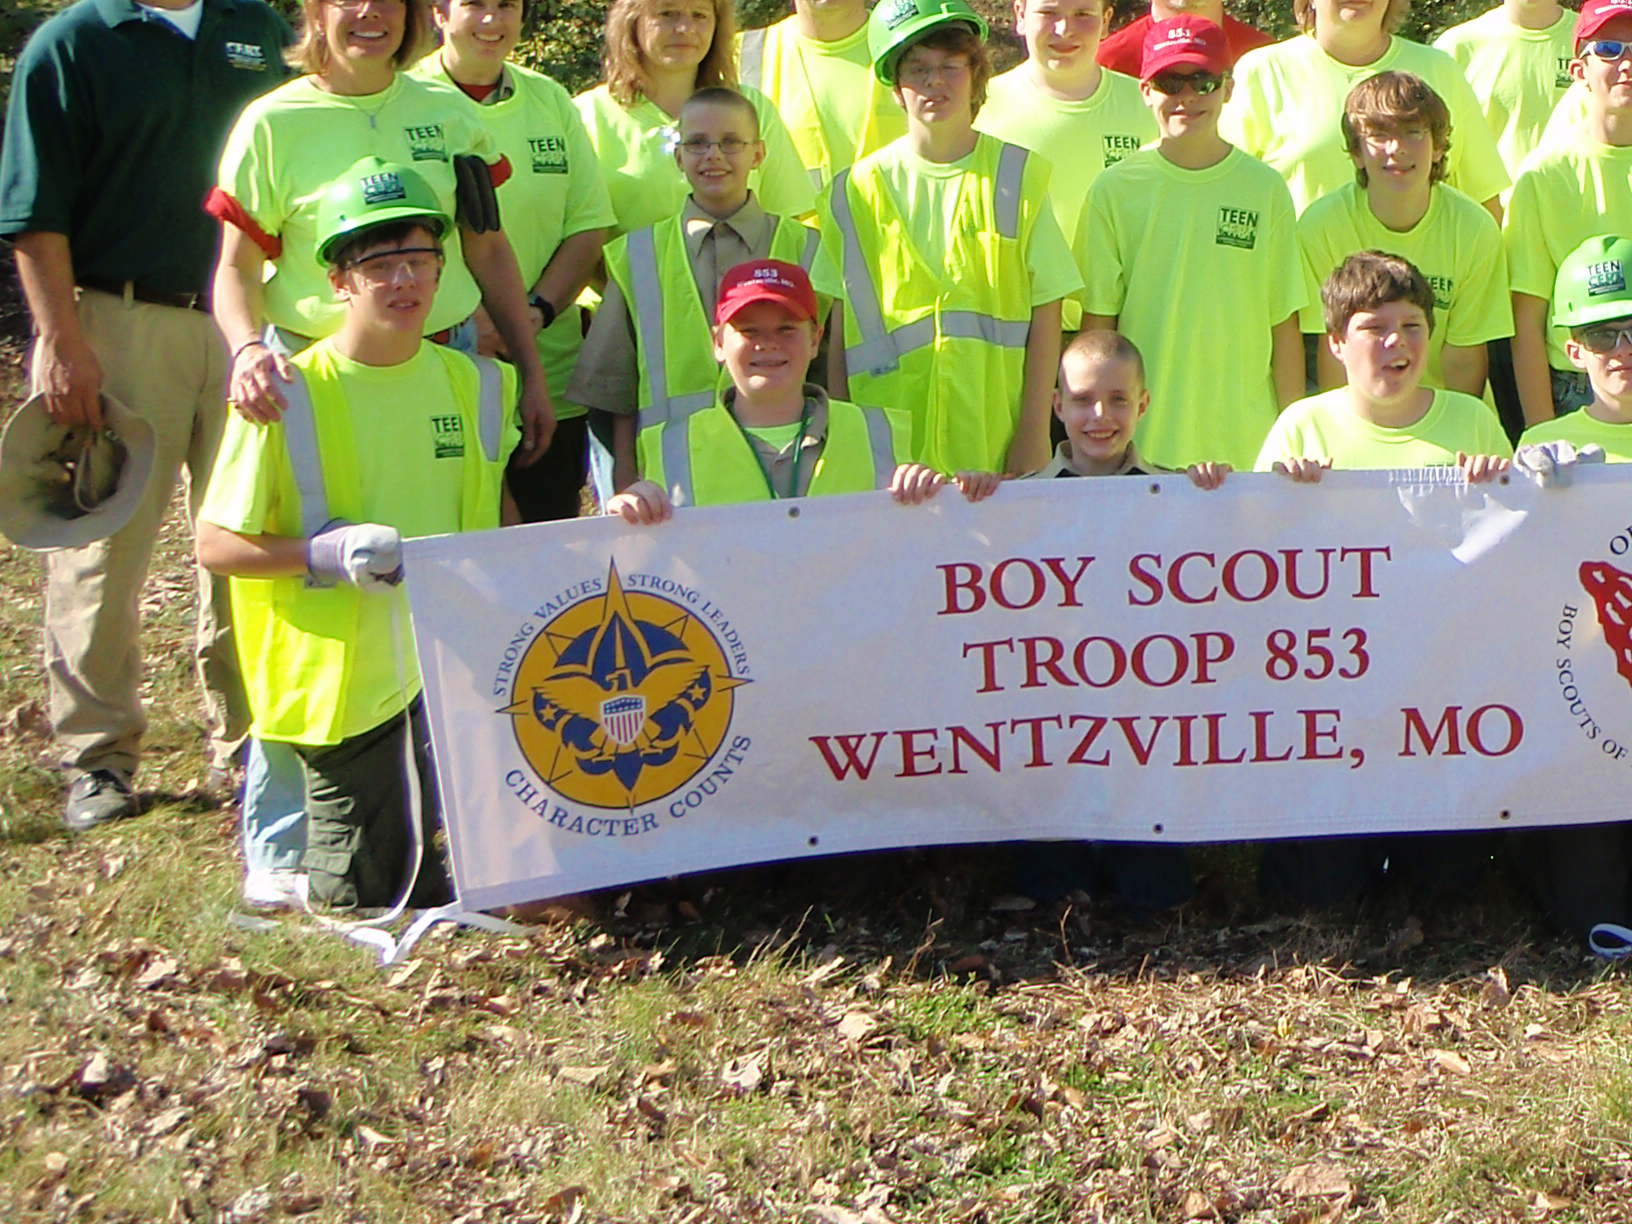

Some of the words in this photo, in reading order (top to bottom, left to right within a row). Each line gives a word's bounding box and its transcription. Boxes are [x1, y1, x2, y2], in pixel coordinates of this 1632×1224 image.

[405, 125, 445, 141] TEEN
[528, 137, 566, 153] TEEN
[1104, 136, 1141, 149] TEEN
[1221, 207, 1259, 226] TEEN
[1588, 260, 1621, 276] TEEN
[936, 555, 1096, 616] BOY
[1127, 545, 1392, 607] SCOUT
[493, 623, 534, 697] STRONG
[534, 577, 603, 622] VALUES
[627, 573, 700, 604] STRONG
[700, 601, 751, 676] LEADERS
[1556, 603, 1579, 650] BOY
[962, 630, 1235, 694] TROOP
[1264, 626, 1371, 681] 853
[1556, 657, 1602, 741] SCOUTS
[808, 708, 1366, 782] WENTZVILLE,
[1398, 704, 1525, 757] MO
[1601, 738, 1629, 761] OF
[505, 768, 660, 838] CHARACTER
[669, 734, 752, 819] COUNTS
